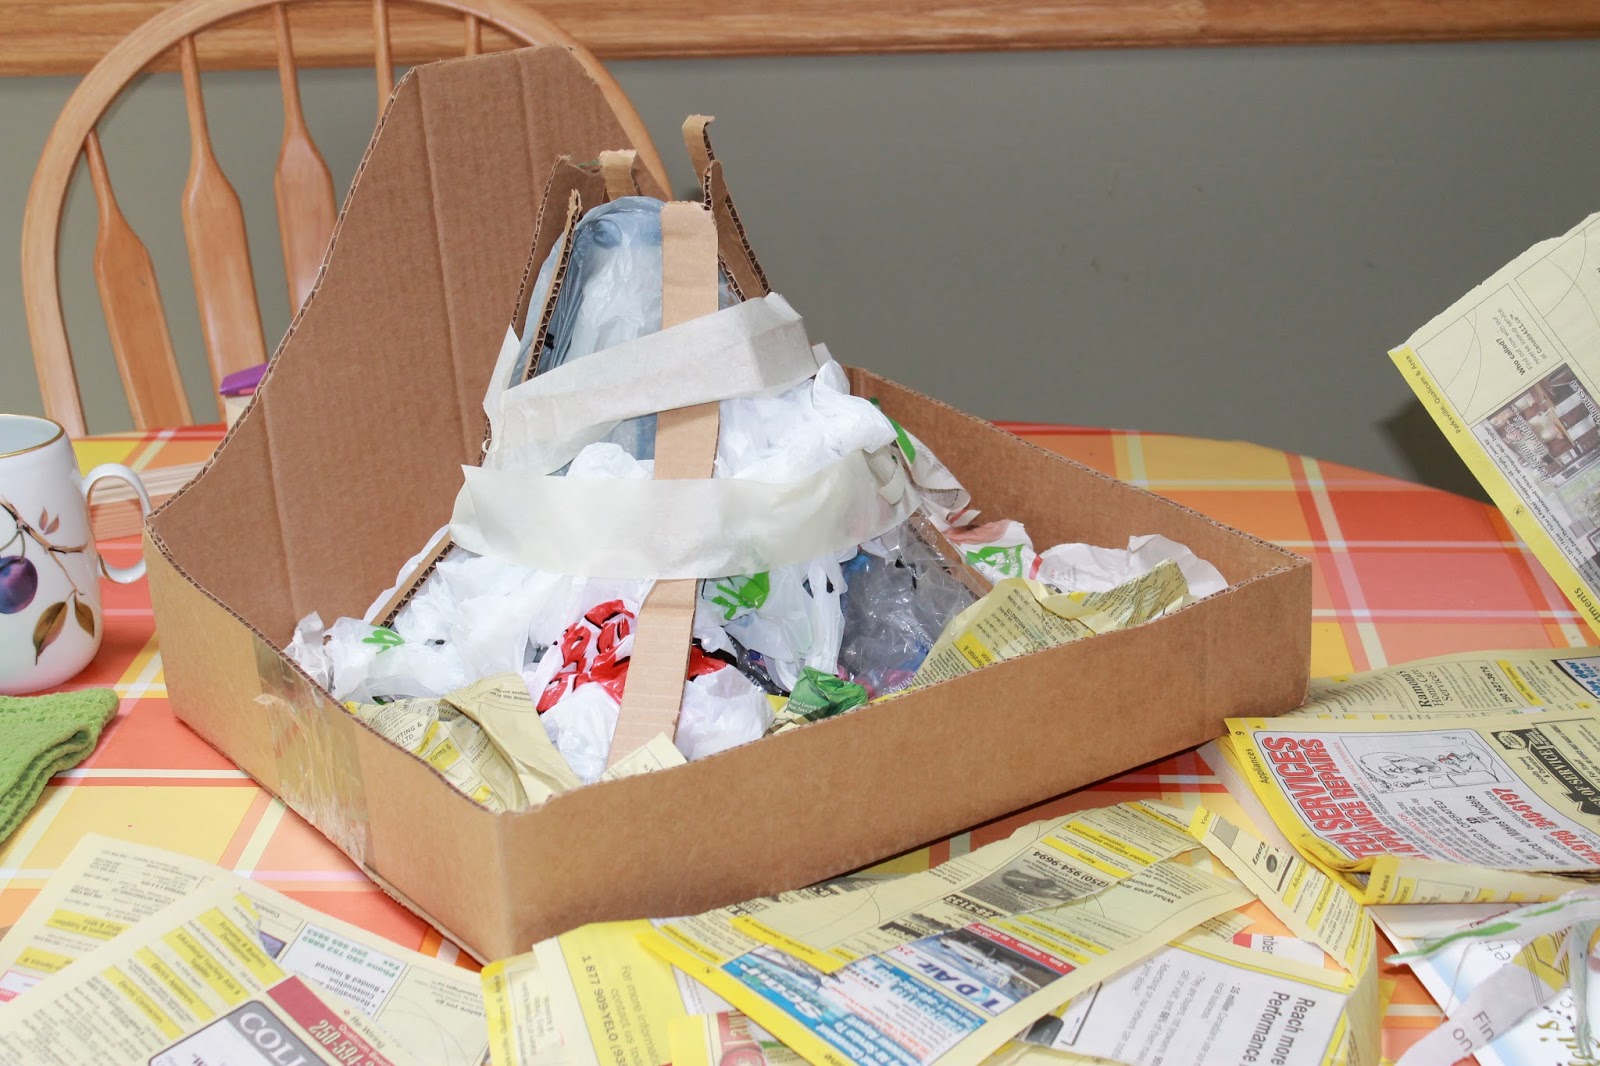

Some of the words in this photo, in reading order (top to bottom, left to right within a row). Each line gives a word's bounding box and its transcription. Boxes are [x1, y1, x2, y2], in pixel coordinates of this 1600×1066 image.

[1496, 308, 1512, 327] service
[1495, 336, 1515, 360] called?
[1404, 355, 1417, 370] Area
[1512, 359, 1526, 375] Who
[1521, 357, 1533, 370] Find
[1418, 376, 1441, 404] Qualicum
[1411, 668, 1427, 682] Care
[1395, 670, 1432, 706] Ramona's
[1424, 683, 1443, 706] Home
[1426, 671, 1453, 701] Services
[401, 733, 414, 744] LTD
[445, 742, 452, 750] &
[1244, 747, 1269, 783] Appliances
[1297, 739, 1357, 798] REPAIRS
[1538, 749, 1582, 784] SERVICE
[1260, 734, 1353, 831] SERVICES
[1574, 784, 1595, 796] OF
[1465, 794, 1490, 816] Models
[1433, 800, 1470, 829] OPERATED
[1495, 820, 1521, 836] Makes
[1080, 873, 1108, 888] (250)
[1127, 877, 1154, 887] around
[1380, 874, 1389, 891] Area
[1133, 886, 1153, 894] goes
[1152, 892, 1174, 903] What
[1156, 886, 1181, 899] comes
[314, 961, 343, 977] Insured
[365, 961, 395, 977] Phone
[382, 959, 400, 970] Fax
[917, 964, 960, 979] Air
[328, 976, 374, 999] Construction
[351, 976, 380, 991] Bonded
[324, 983, 370, 1006] Renovations
[584, 963, 600, 986] 877
[592, 987, 618, 1042] 909-YELO
[1284, 997, 1316, 1031] Reach
[1242, 990, 1290, 1063] Performance
[1270, 1034, 1294, 1066] more
